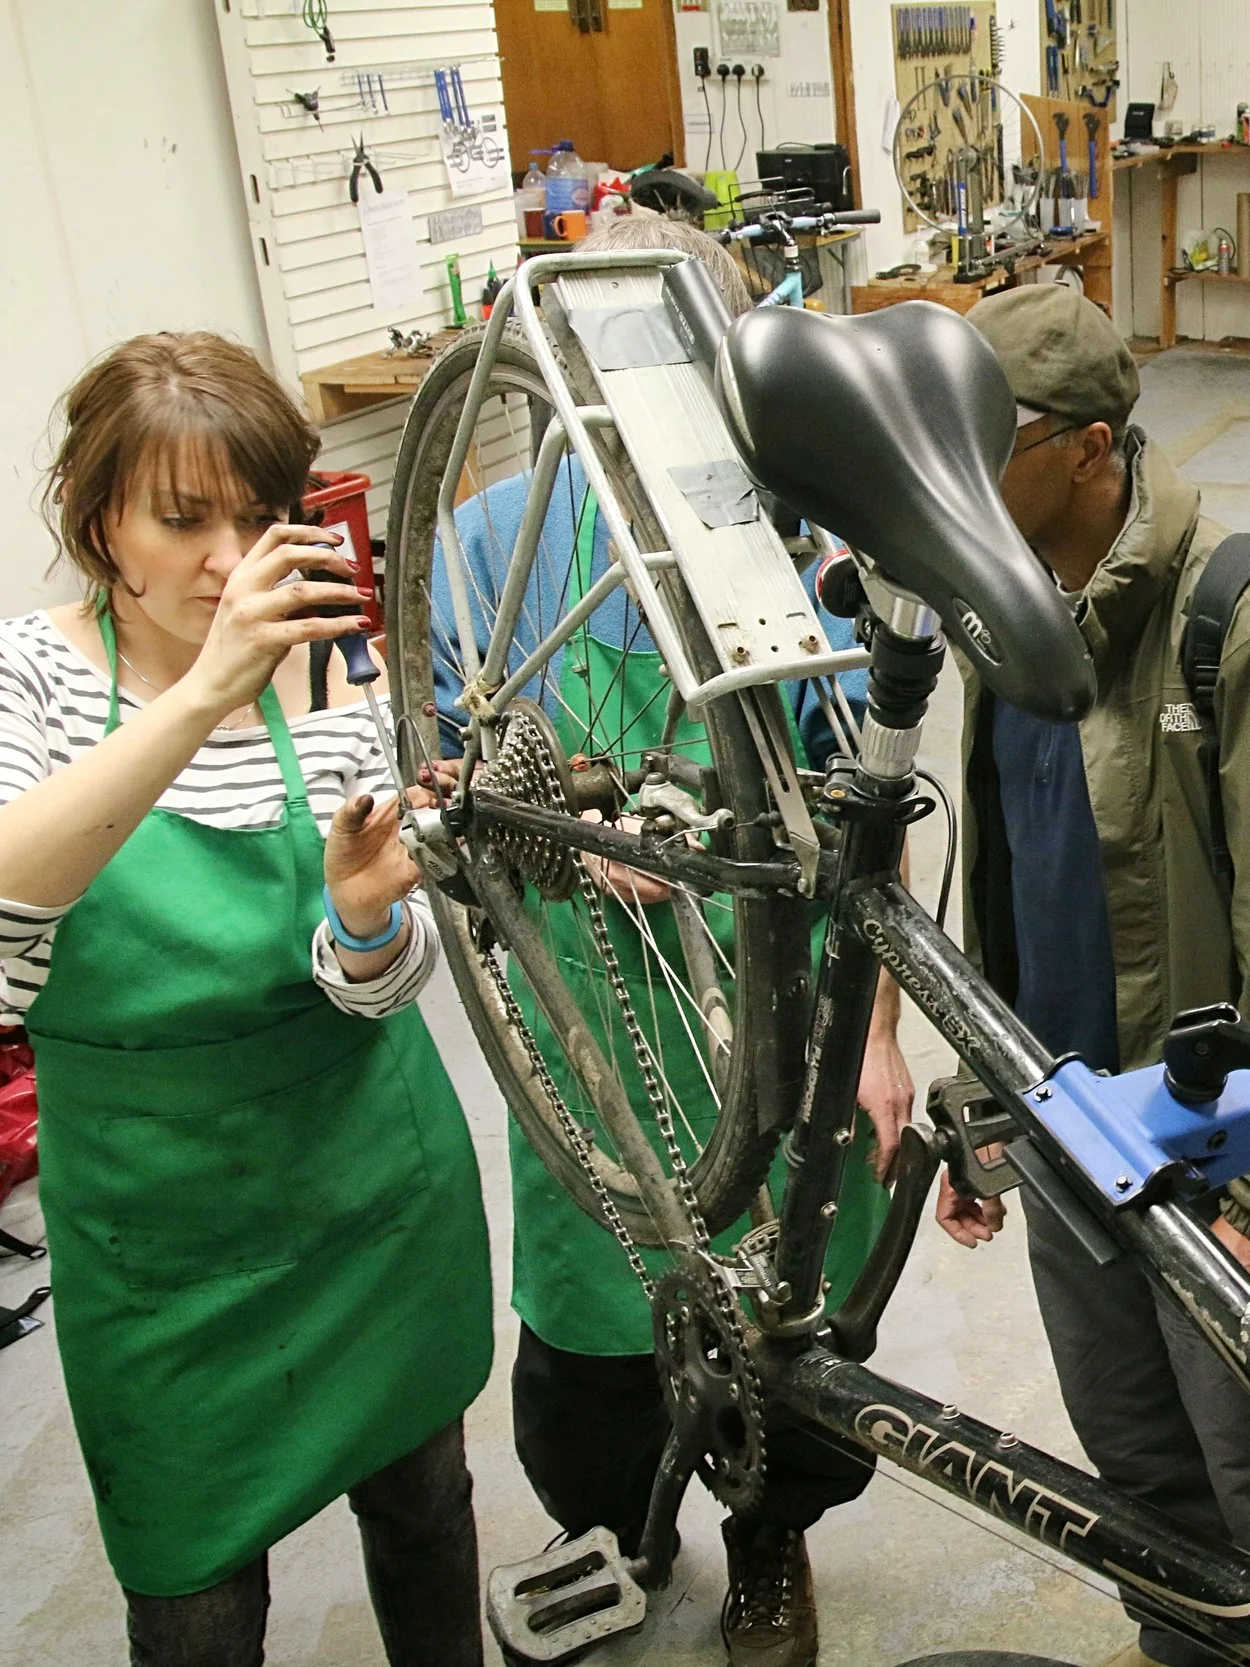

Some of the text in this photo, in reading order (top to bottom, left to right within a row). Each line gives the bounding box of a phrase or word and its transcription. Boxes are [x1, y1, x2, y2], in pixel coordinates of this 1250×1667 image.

[1165, 703, 1187, 713] THE
[1159, 713, 1187, 723] ORTH
[1161, 722, 1189, 732] FACE
[863, 919, 941, 1017] Cypress
[855, 1404, 1100, 1549] GIANT
